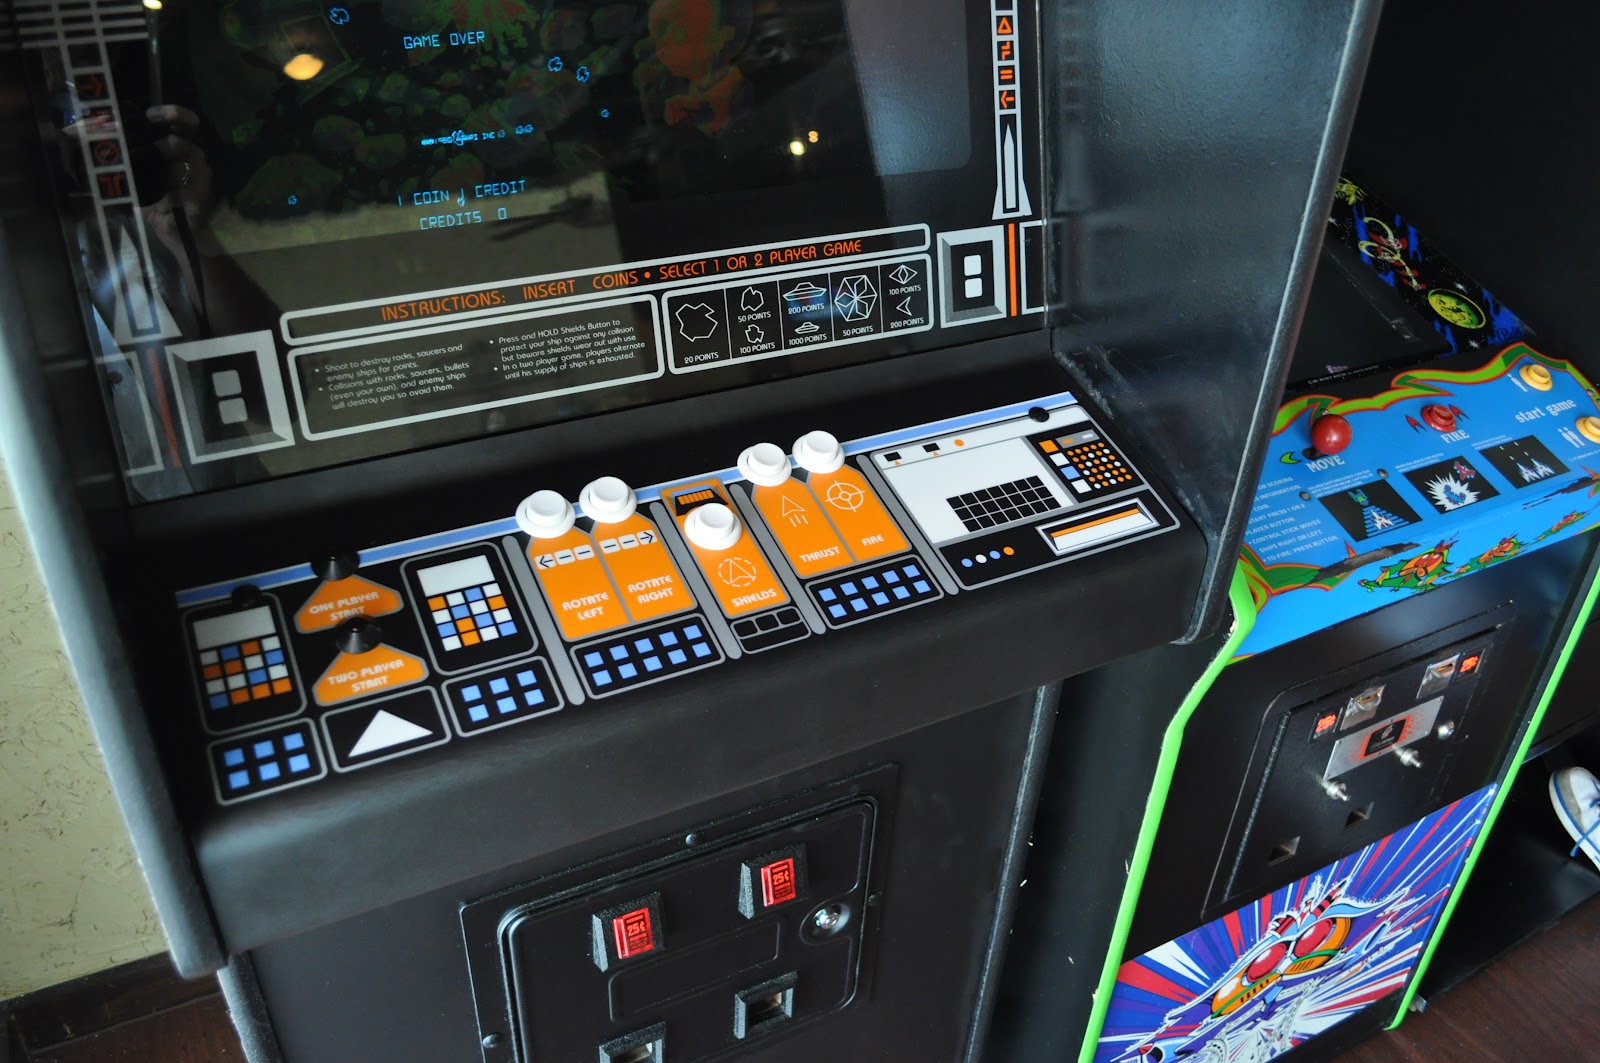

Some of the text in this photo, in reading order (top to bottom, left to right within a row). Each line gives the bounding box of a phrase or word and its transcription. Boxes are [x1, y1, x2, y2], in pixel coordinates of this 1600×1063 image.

[403, 31, 485, 49] GAME OVER
[413, 190, 450, 205] COIN
[475, 180, 525, 197] CREDIT
[420, 211, 481, 230] CREDITS
[660, 240, 862, 280] SELECT 1 OR 2 PLAYER GAME
[381, 271, 639, 321] INSTRUCTIONS: INSERT COINS
[889, 284, 922, 296] 100 POINTS
[738, 310, 771, 323] 50 POINTS
[788, 302, 825, 315] 200 POINTS
[890, 316, 924, 328] 200 POINTS
[499, 336, 519, 344] Press
[521, 332, 535, 340] and
[538, 329, 559, 338] HOLD
[561, 324, 586, 334] Shields
[588, 321, 610, 330] Button
[788, 333, 828, 346] 1000 POINTS
[842, 325, 874, 337] 50 POINTS
[501, 326, 634, 355] protect your ship against any collision
[502, 354, 514, 362] but
[516, 350, 545, 360] beware
[547, 344, 571, 354] shields
[574, 342, 592, 350] wear
[607, 336, 622, 344] with
[739, 341, 776, 355] 100 POINTS
[325, 363, 349, 372] Shoot
[361, 356, 391, 367] destroy
[417, 348, 446, 357] saucers
[448, 344, 462, 353] and
[519, 360, 533, 368] two
[536, 356, 558, 366] player
[586, 348, 611, 358] players
[614, 342, 645, 352] alternate
[684, 351, 719, 365] 20 POINTS
[327, 373, 354, 381] enemy
[356, 367, 377, 377] ships
[379, 364, 390, 372] for
[505, 372, 520, 380] until
[522, 369, 532, 377] his
[534, 365, 558, 375] supply
[560, 362, 567, 370] of
[570, 360, 587, 368] ships
[597, 352, 635, 364] exhausted.
[328, 378, 364, 391] Collisions
[366, 376, 383, 385] with
[444, 362, 469, 371] bullets
[356, 388, 373, 397] your
[401, 380, 416, 388] and
[419, 377, 444, 385] enemy
[447, 372, 466, 381] ships
[332, 402, 345, 410] will
[347, 397, 378, 408] destroy
[380, 395, 395, 403] you
[409, 388, 430, 396] avoid
[1514, 399, 1577, 424] start game
[1439, 429, 1471, 444] FIRE
[1306, 456, 1345, 472] MOVE
[1268, 477, 1293, 486] SCORING
[1267, 509, 1287, 518] PRESS
[1245, 525, 1269, 535] PLAYER
[1252, 519, 1321, 544] CONTROL STICK MOVES
[862, 533, 885, 546] FIRE
[1259, 544, 1277, 553] SHIPS
[1278, 538, 1297, 548] RIGHT
[1293, 543, 1313, 553] PRESS
[799, 545, 840, 563] THRUST
[628, 574, 673, 593] ROTATE
[309, 591, 380, 614] ONE PLAYER
[562, 592, 610, 612] ROTATE
[637, 587, 674, 604] RIGHT
[732, 588, 778, 608] SHIELDS
[330, 606, 365, 621] START
[577, 606, 604, 620] LEFT
[327, 659, 404, 685] TWO PLAYER
[352, 676, 389, 692] START
[772, 870, 790, 886] 25¢
[627, 920, 646, 937] 25¢
